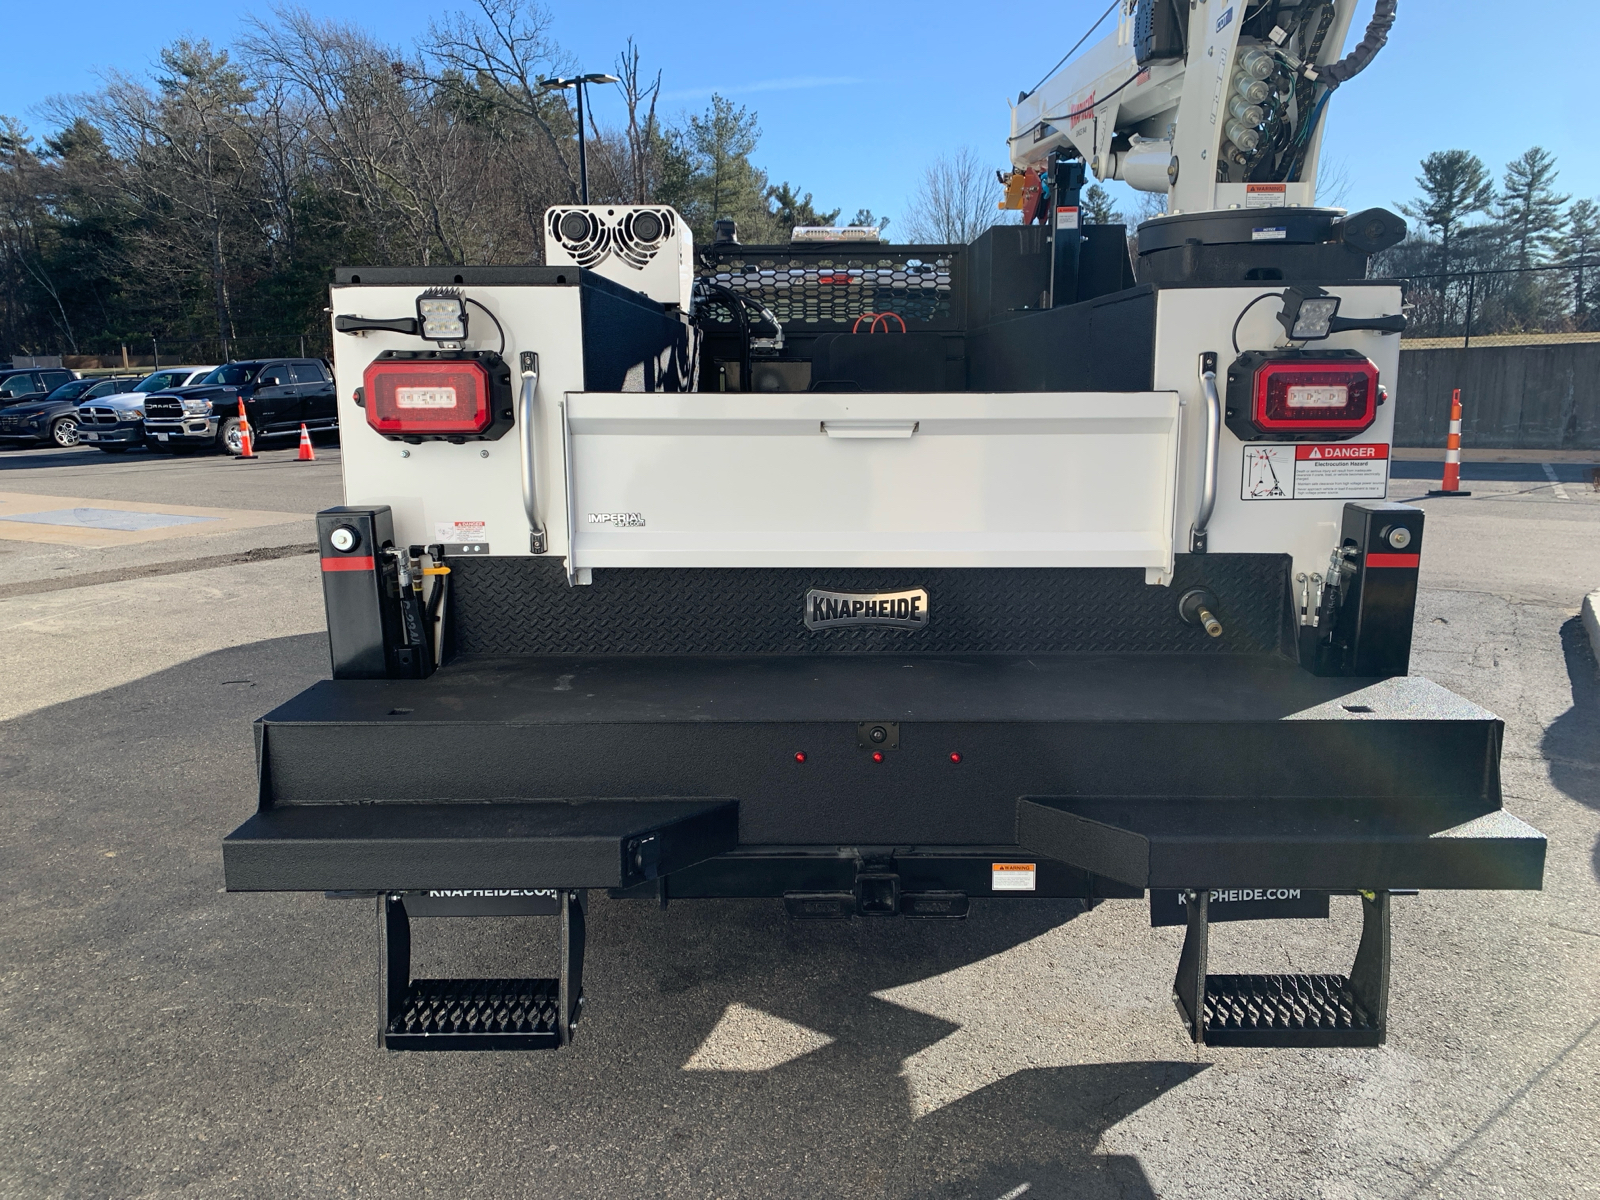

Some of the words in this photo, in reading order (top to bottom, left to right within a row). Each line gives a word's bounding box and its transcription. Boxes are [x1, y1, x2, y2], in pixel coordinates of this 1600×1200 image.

[1324, 447, 1375, 457] DANGER
[588, 513, 644, 523] IMPERIAL
[813, 596, 921, 621] KNAPHEIDE
[1178, 889, 1300, 905] KPHEIDE.COM
